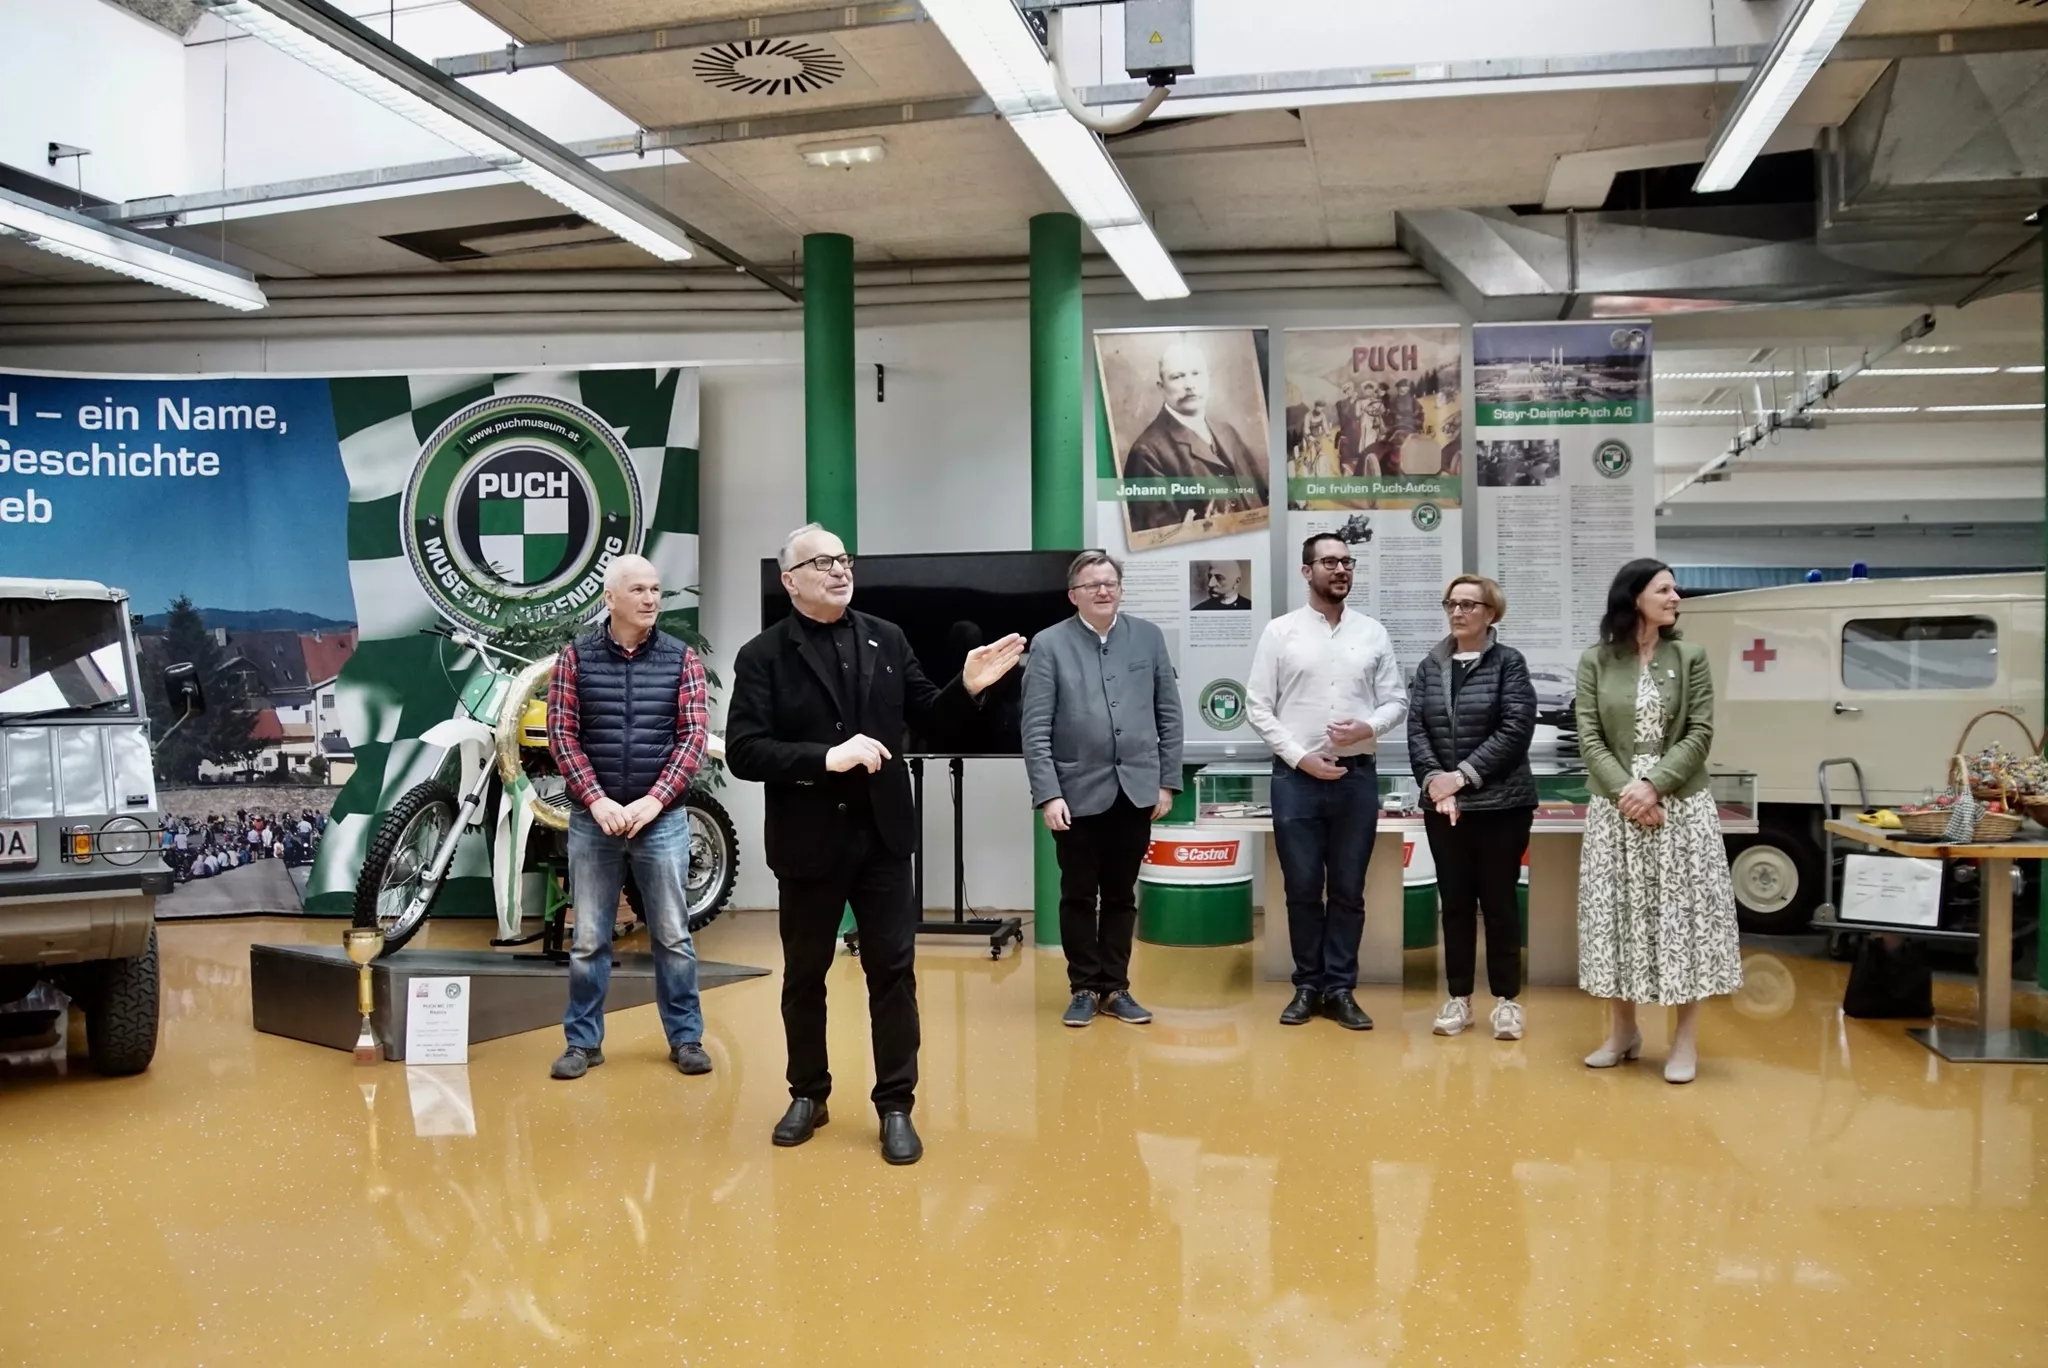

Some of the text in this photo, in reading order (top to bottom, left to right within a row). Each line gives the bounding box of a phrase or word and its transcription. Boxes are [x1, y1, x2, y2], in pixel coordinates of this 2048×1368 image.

[1352, 344, 1418, 373] PUCH
[78, 397, 139, 430] ein
[157, 397, 287, 435] Name,
[1493, 406, 1633, 421] Steyr-Daimler-Puch AG
[467, 418, 580, 445] www.puchmuseum.at
[478, 471, 569, 498] PUCH
[1116, 484, 1166, 496] Johann
[1171, 483, 1205, 495] Puch
[1307, 483, 1326, 494] Die
[1372, 482, 1441, 493] Puch-Autos
[1189, 847, 1229, 861] Castrol
